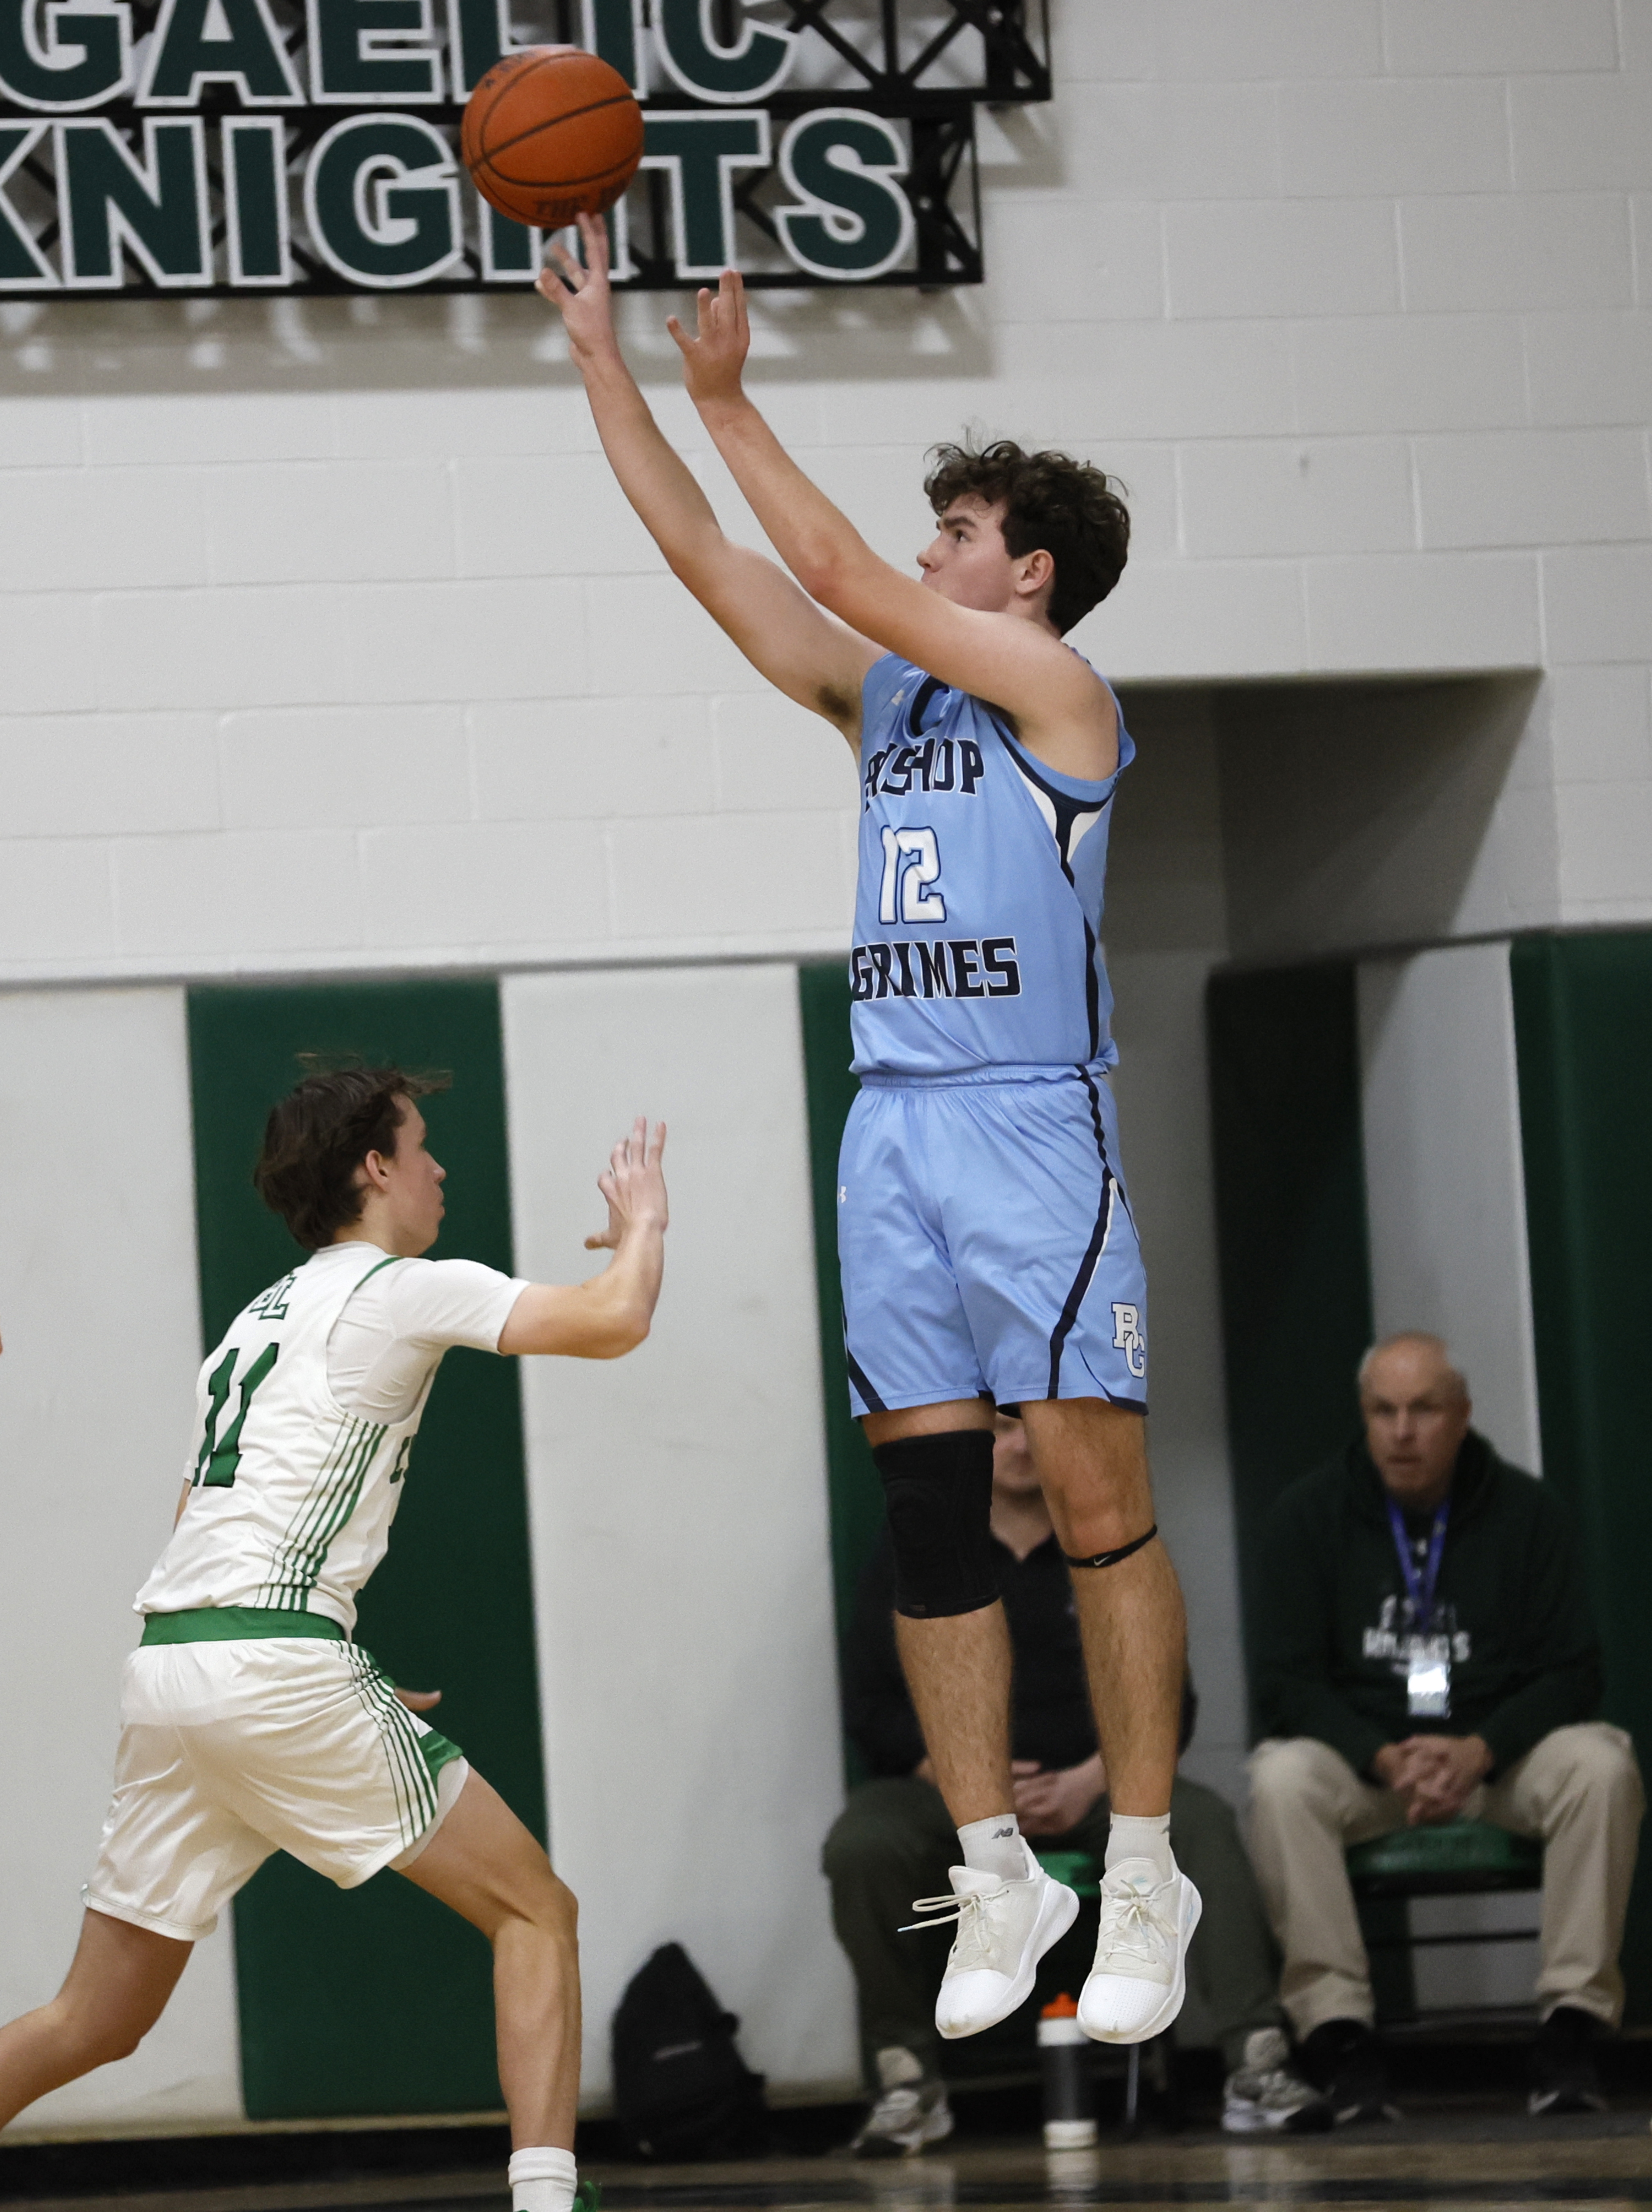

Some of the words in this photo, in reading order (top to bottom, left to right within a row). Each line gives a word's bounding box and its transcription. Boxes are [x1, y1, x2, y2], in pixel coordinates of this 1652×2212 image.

[879, 824, 947, 925] 12
[850, 936, 1022, 1002] GRIMES
[192, 1342, 280, 1488] 11
